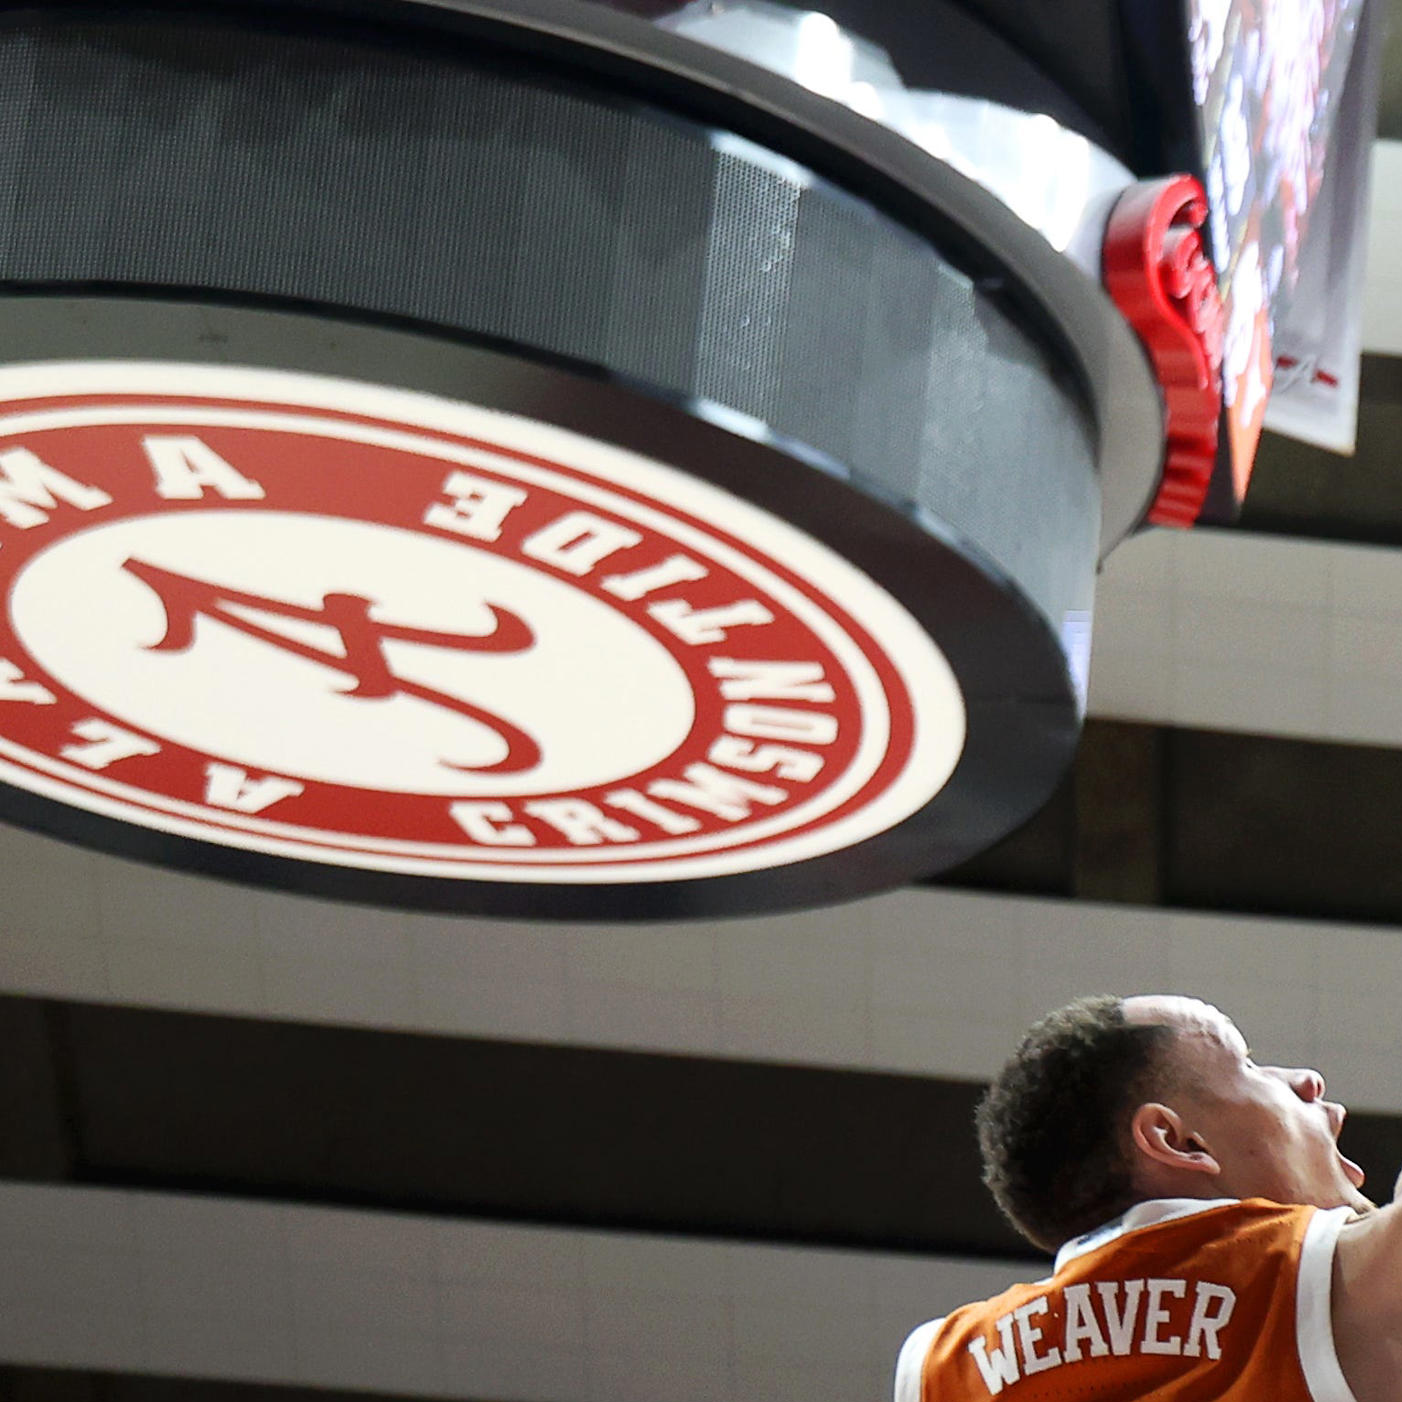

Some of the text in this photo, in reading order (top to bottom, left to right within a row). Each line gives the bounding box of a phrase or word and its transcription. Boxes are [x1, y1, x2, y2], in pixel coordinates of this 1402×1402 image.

[423, 470, 838, 846] CRIMSON TIDE
[968, 1279, 1236, 1396] WEAVER
